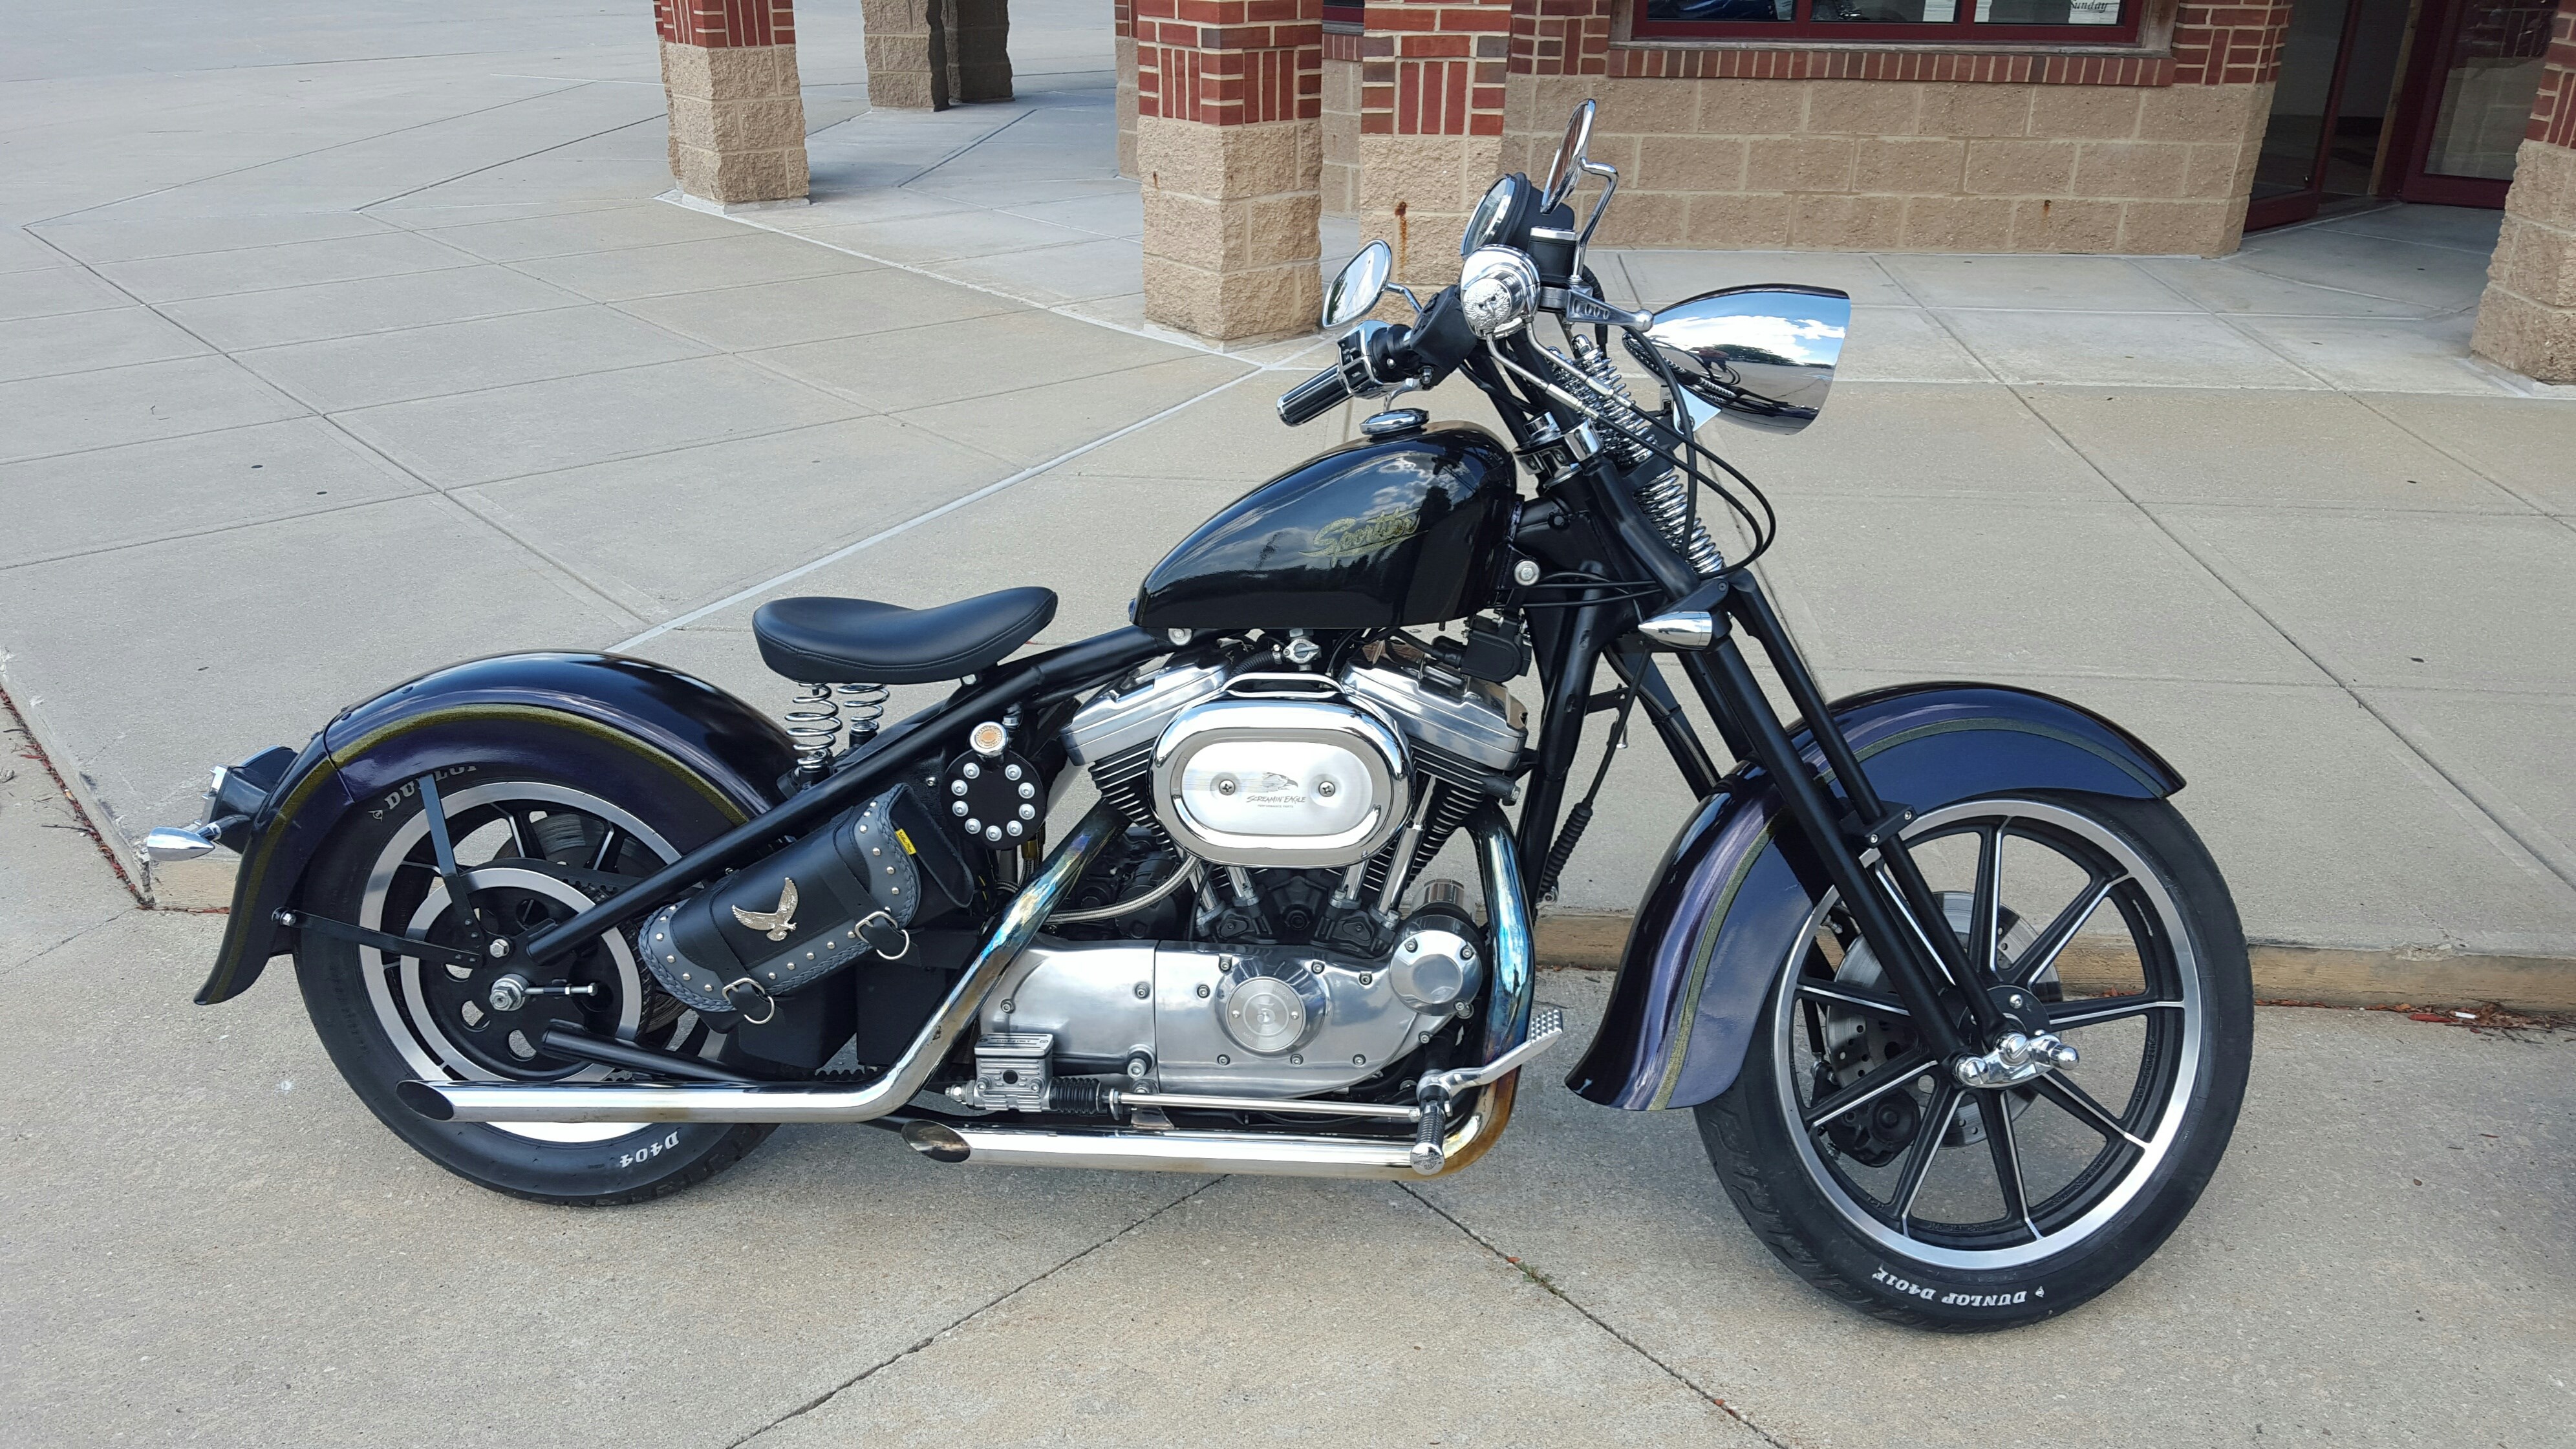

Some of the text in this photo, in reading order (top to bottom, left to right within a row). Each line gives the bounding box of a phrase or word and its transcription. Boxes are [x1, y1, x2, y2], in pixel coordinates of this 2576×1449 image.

[384, 766, 477, 810] DULO
[1284, 795, 1307, 804] EAGLE
[619, 1131, 680, 1168] D404
[1941, 1290, 2027, 1307] DUNLOP
